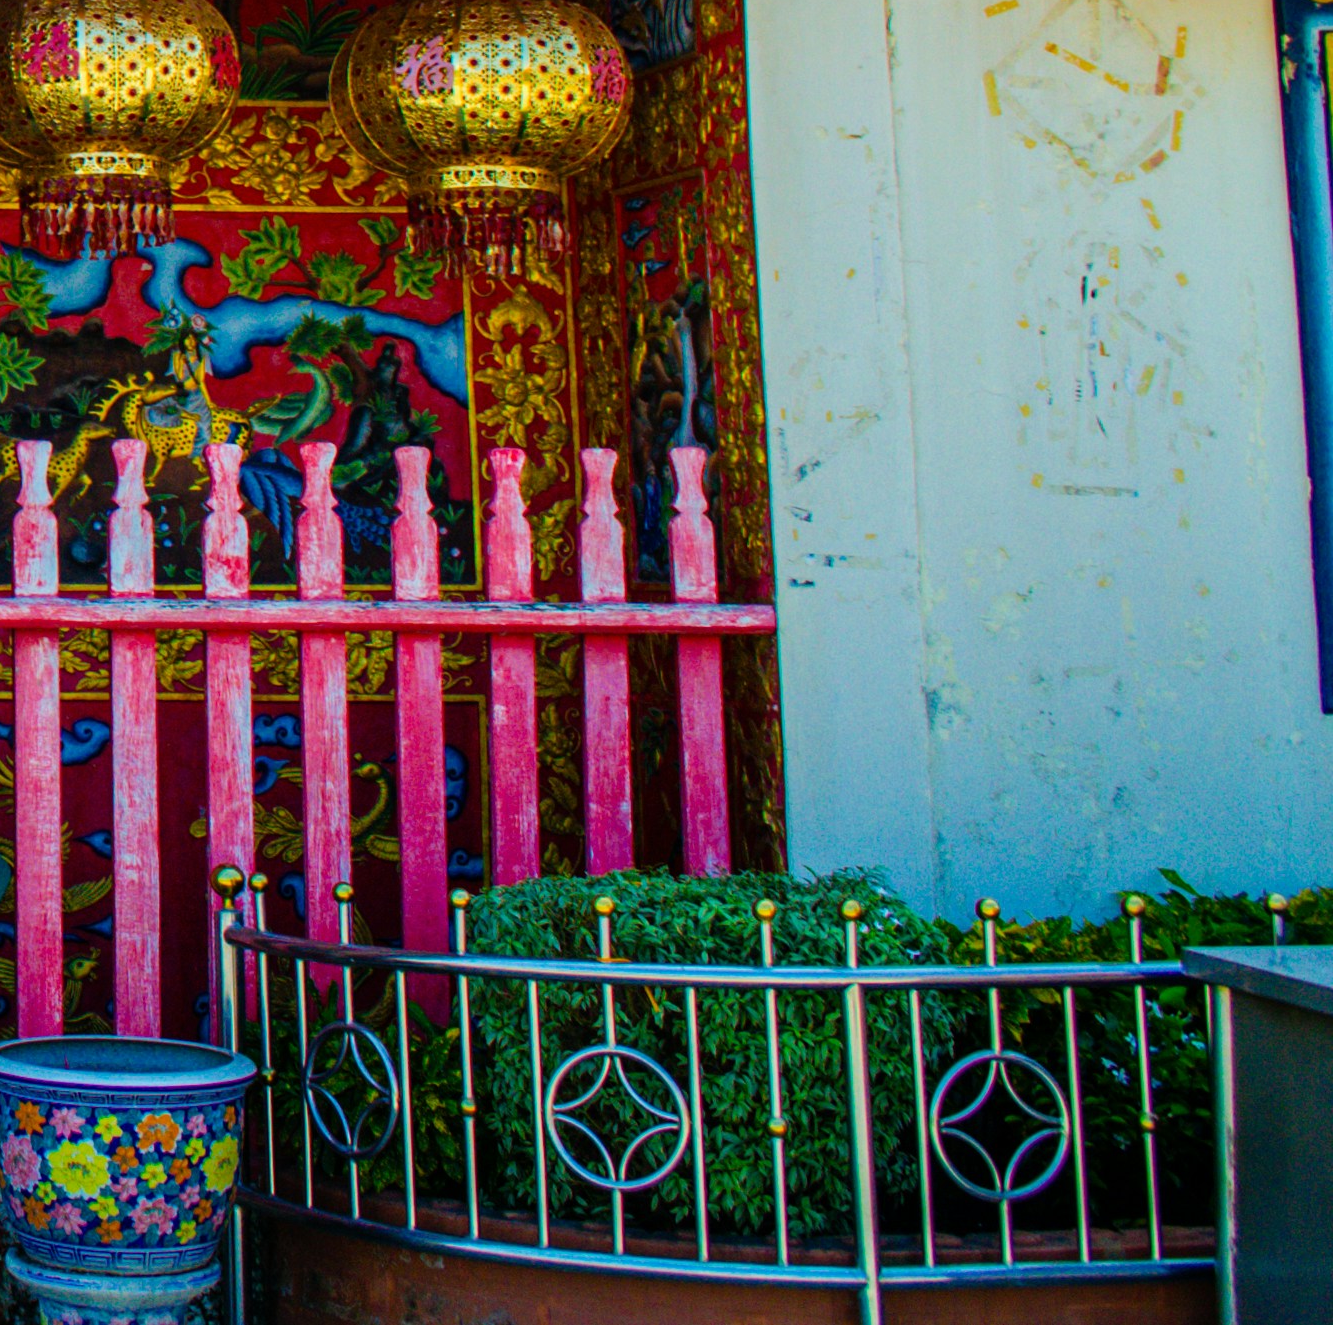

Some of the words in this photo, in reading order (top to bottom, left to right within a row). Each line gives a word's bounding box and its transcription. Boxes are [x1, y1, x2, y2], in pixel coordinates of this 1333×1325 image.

[20, 21, 80, 83] 福
[395, 35, 455, 98] 福
[590, 48, 628, 102] 福
